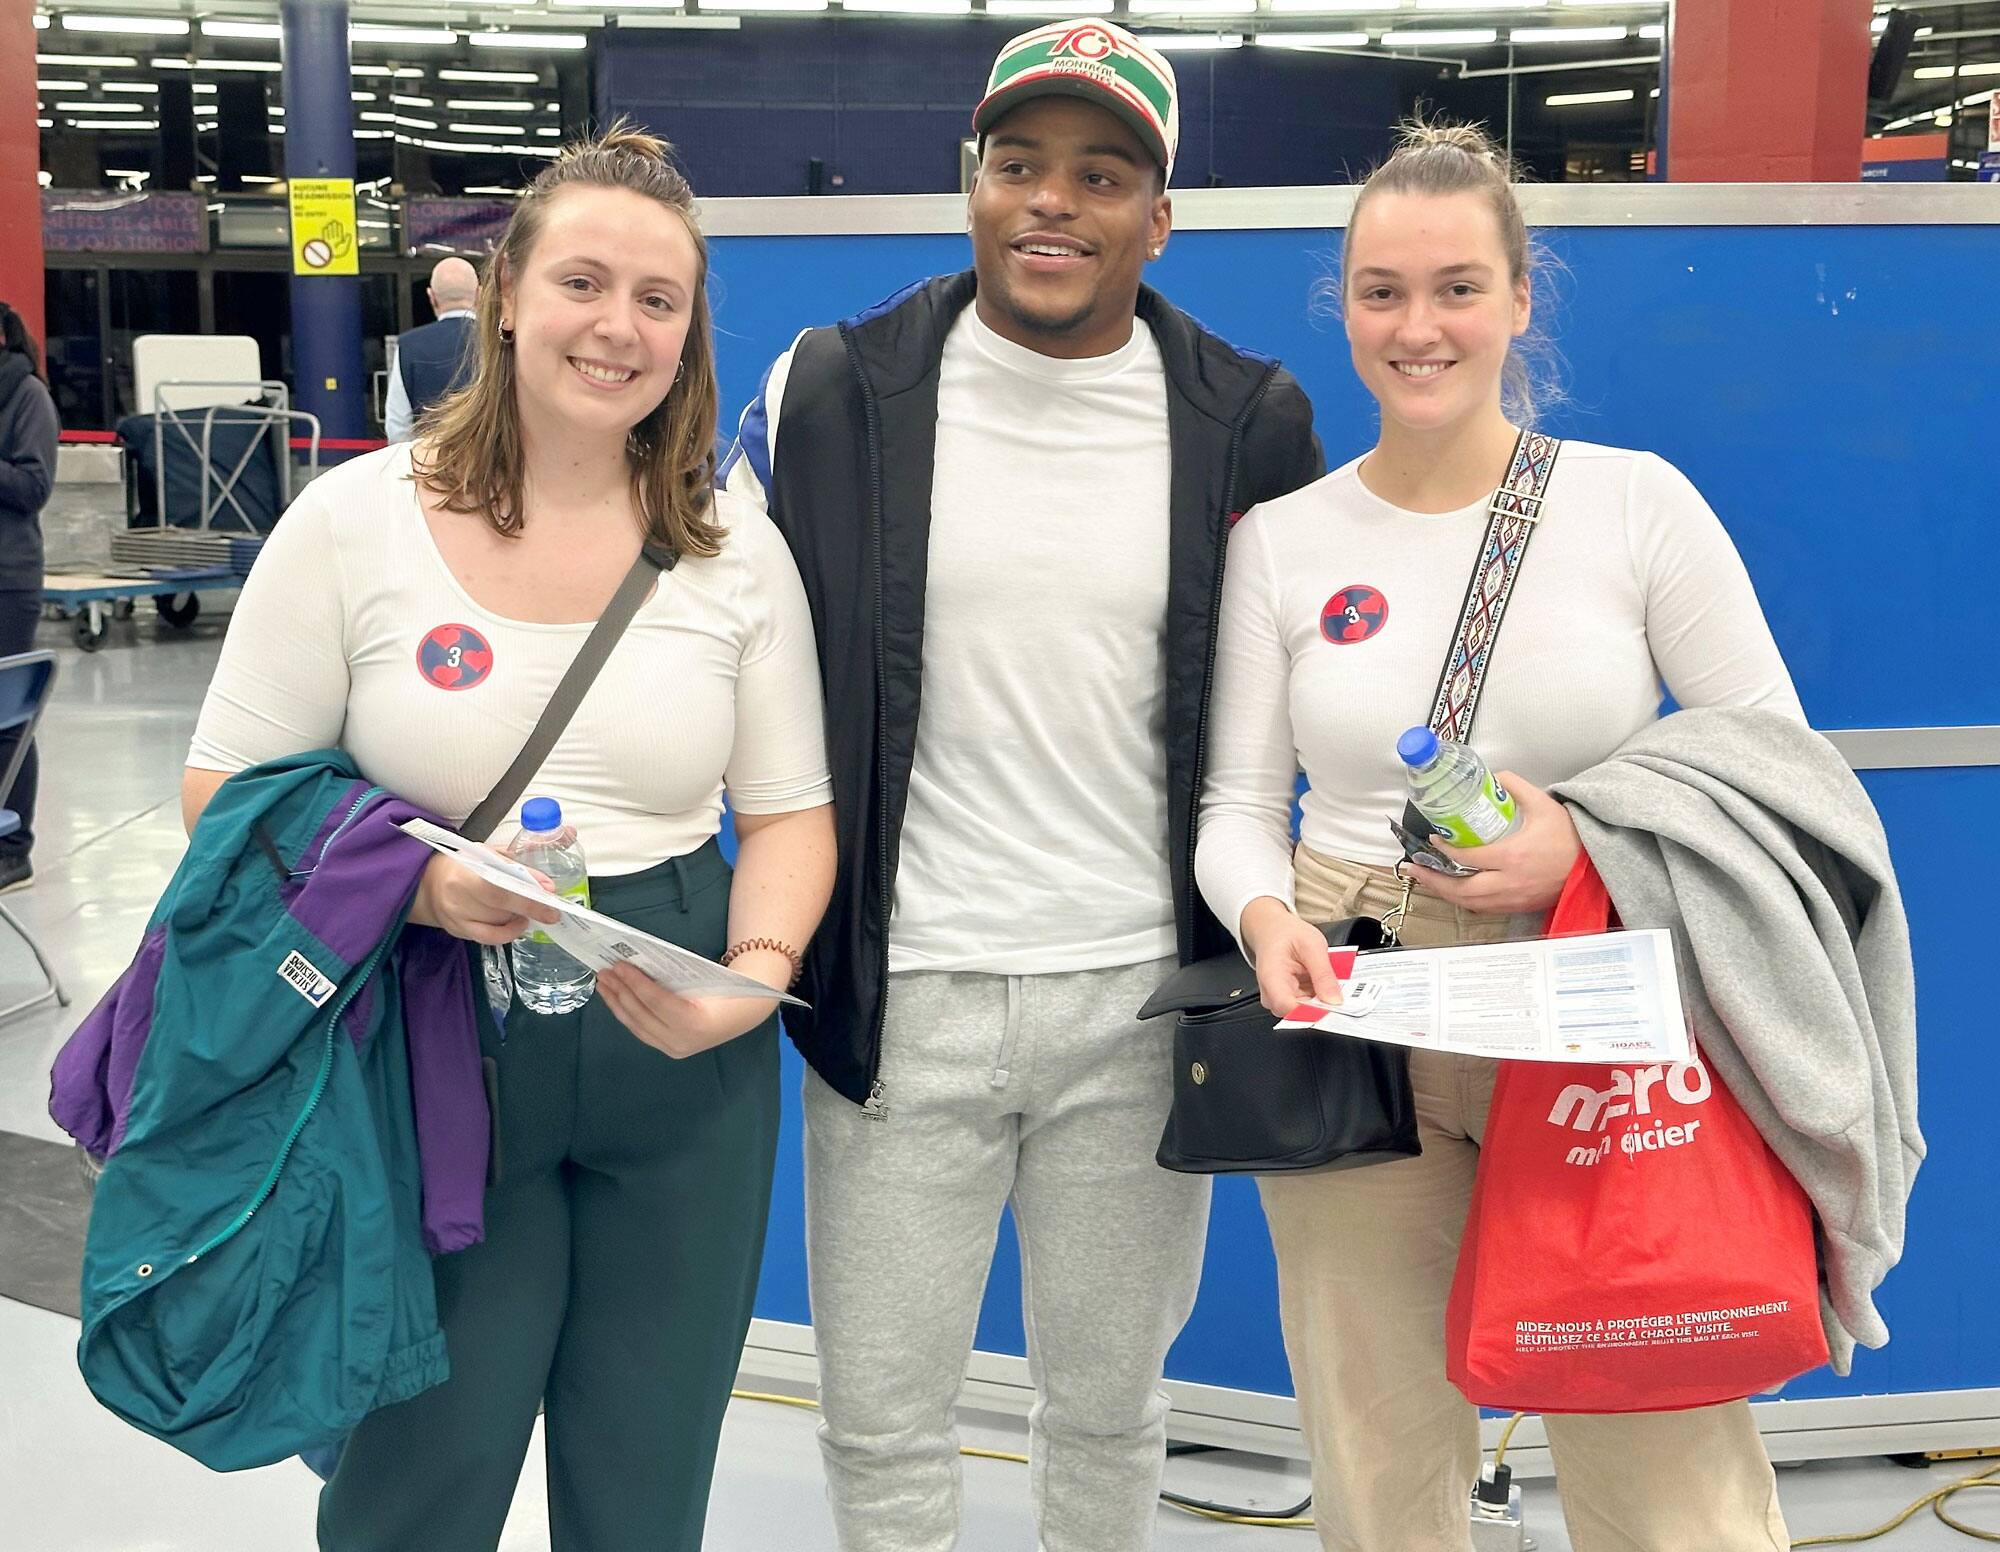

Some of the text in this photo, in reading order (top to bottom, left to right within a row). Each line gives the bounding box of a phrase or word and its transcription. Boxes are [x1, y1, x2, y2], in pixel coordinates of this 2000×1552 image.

[1344, 605, 1360, 624] 3
[447, 646, 462, 668] 3
[283, 963, 310, 990] SIERRA
[289, 955, 318, 983] DESIGNS
[1565, 1135, 1611, 1166] mn
[1515, 1301, 1791, 1333] AIDEZ-NOUS À PROTÉGER L'ENVIRONNEMENT.
[1515, 1321, 1733, 1345] RÉUTILISEZ CE SAC À CHAQUE VISITE.
[1548, 1344, 1579, 1352] PROTECT
